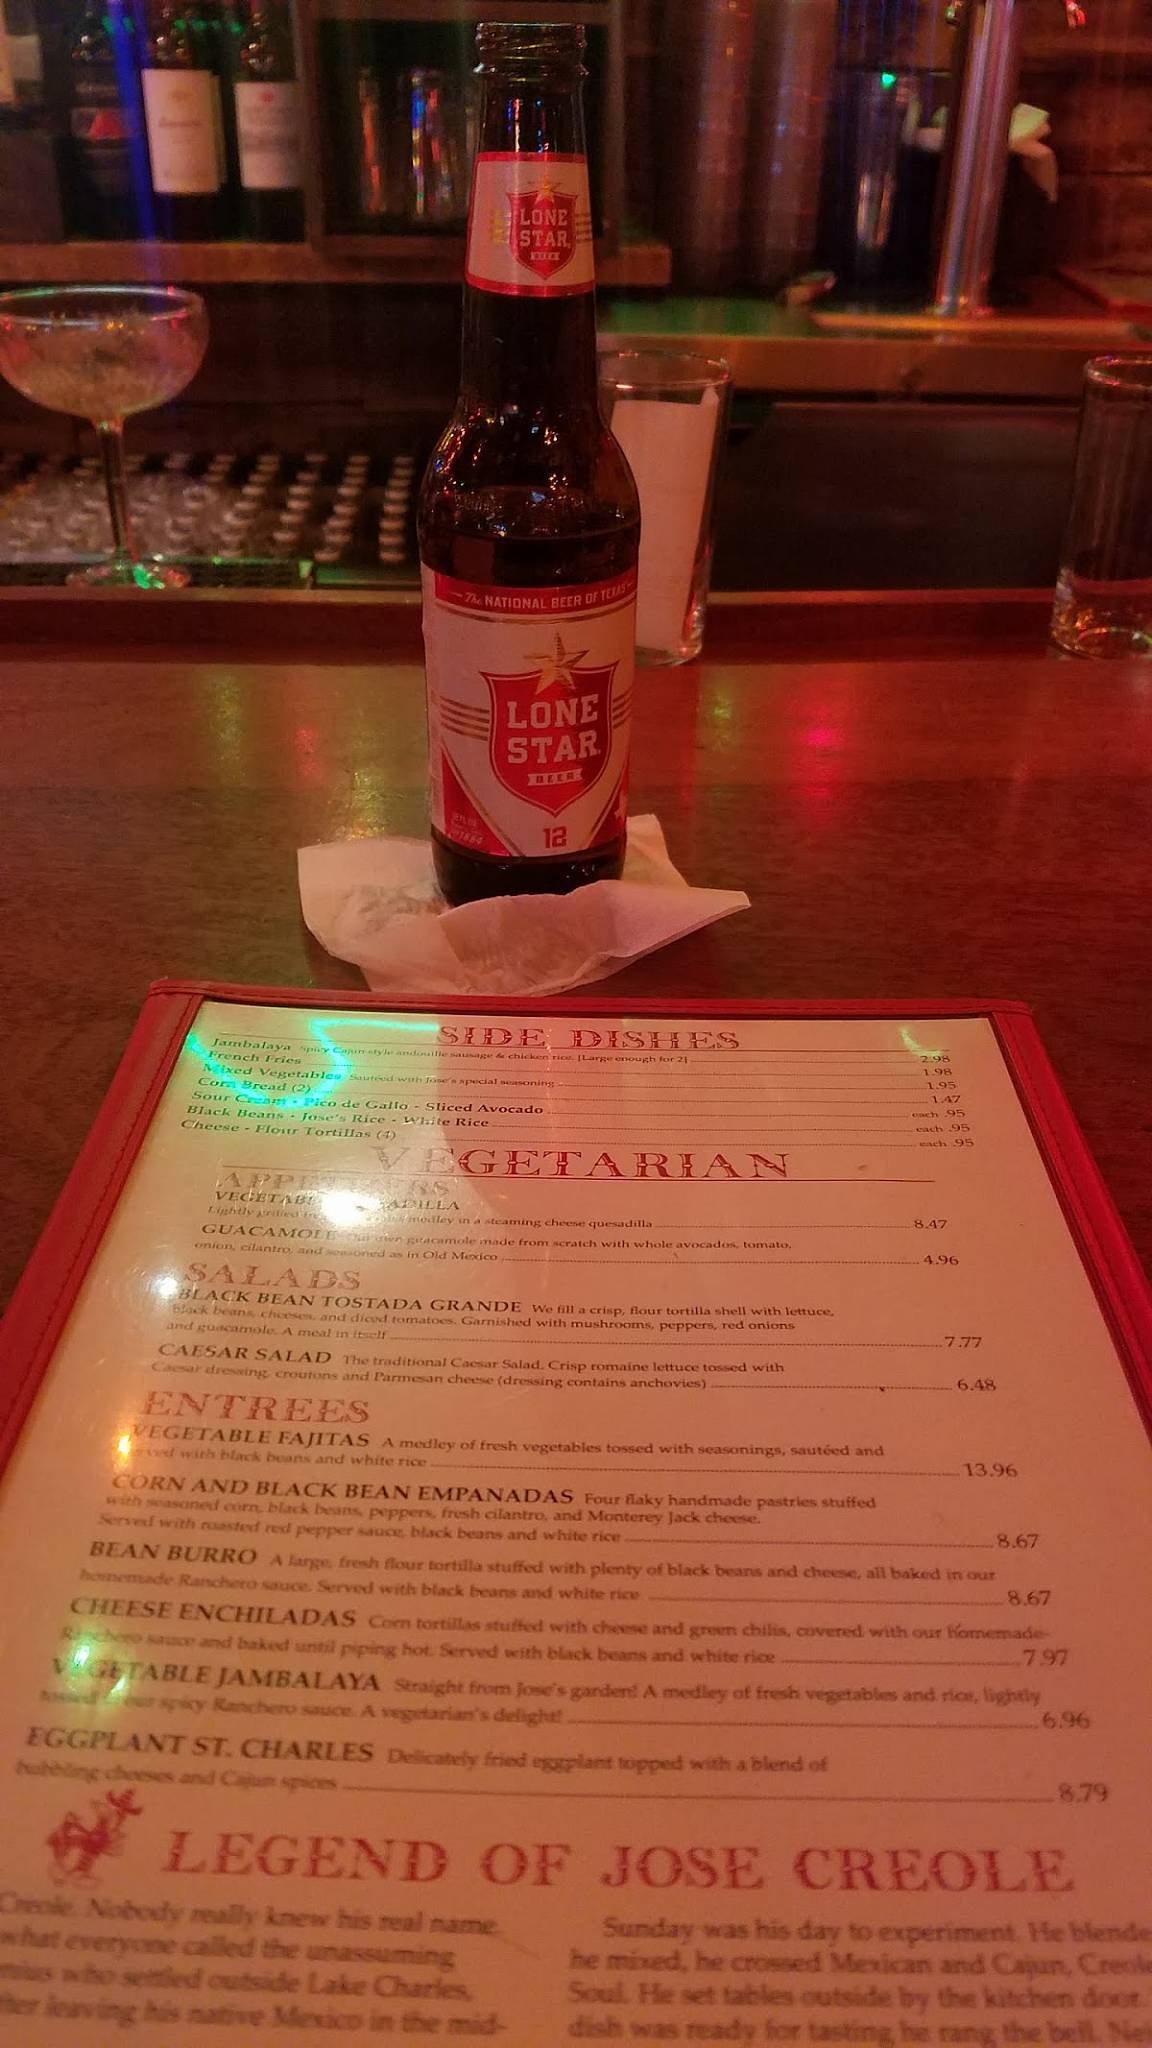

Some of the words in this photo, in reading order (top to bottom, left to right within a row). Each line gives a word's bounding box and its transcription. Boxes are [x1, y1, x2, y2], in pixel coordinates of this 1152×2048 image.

[520, 208, 568, 225] LONE
[520, 230, 569, 247] STAR
[484, 594, 547, 609] NATIONAL
[551, 593, 581, 608] BEER
[585, 591, 598, 605] OF
[600, 585, 626, 602] TEXAS
[508, 695, 599, 729] LONE
[508, 730, 600, 764] STAR
[536, 772, 575, 784] BEER
[543, 826, 567, 849] 12
[437, 1026, 546, 1047] SIDE
[569, 1029, 740, 1049] DISHES
[212, 1038, 291, 1052] Jambalaya
[615, 1055, 656, 1063] enough
[921, 1055, 950, 1063] 2.98
[203, 1064, 252, 1076] Mixed
[260, 1068, 341, 1081] Vegetables
[459, 1078, 497, 1086] special
[208, 1051, 259, 1063] French
[264, 1053, 301, 1064] Fries
[923, 1068, 952, 1076] 1.98
[198, 1077, 237, 1089] Corn
[242, 1081, 286, 1092] Bread
[292, 1083, 310, 1093] (2)
[931, 1095, 960, 1104] 1.47
[192, 1091, 231, 1102] Sour
[304, 1097, 338, 1108] Pico
[341, 1100, 360, 1109] de
[365, 1100, 409, 1110] Gallo
[426, 1102, 472, 1112] Sliced
[478, 1104, 544, 1114] Avocado
[944, 1110, 965, 1118] .95
[187, 1106, 229, 1117] Black
[236, 1108, 284, 1120] Beans
[352, 1114, 386, 1124] Rice
[403, 1116, 450, 1126] White
[455, 1118, 489, 1127] Rice
[916, 1125, 943, 1133] each
[948, 1124, 969, 1132] .95
[182, 1120, 240, 1133] Cheese
[256, 1123, 298, 1136] Flour
[306, 1127, 372, 1138] Tortillas
[376, 1129, 395, 1141] (4)
[953, 1139, 974, 1147] .95
[371, 1147, 790, 1178] VEGETARIAN
[202, 1224, 337, 1240] GUACAMOLE
[553, 1240, 597, 1248] scratch
[601, 1240, 629, 1248] with
[633, 1240, 672, 1249] whole
[914, 1220, 947, 1229] 8.47
[423, 1251, 446, 1260] Old
[452, 1252, 497, 1261] Mexico
[923, 1256, 959, 1265] 4.96
[185, 1263, 361, 1289] SALADS
[179, 1289, 250, 1302] BLACK
[258, 1293, 313, 1306] BEAN
[321, 1296, 422, 1310] TOSTADA
[430, 1299, 521, 1312] GRANDE
[532, 1304, 553, 1314] We
[557, 1304, 574, 1314] fill
[630, 1306, 662, 1315] flour
[666, 1307, 711, 1316] tortilla
[715, 1307, 746, 1316] shell
[751, 1307, 781, 1316] with
[461, 1316, 531, 1328] Garnished
[536, 1318, 566, 1328] with
[722, 1320, 744, 1330] red
[749, 1321, 795, 1330] onions
[945, 1336, 982, 1347] 7.77
[159, 1344, 247, 1359] CAESAR
[255, 1349, 331, 1363] SALAD
[343, 1355, 368, 1366] The
[373, 1355, 447, 1367] traditional
[451, 1358, 496, 1369] Caesar
[548, 1361, 587, 1373] Crisp
[591, 1362, 649, 1372] romaine
[653, 1362, 700, 1372] lettuce
[703, 1362, 746, 1372] tossed
[752, 1363, 784, 1372] with
[958, 1380, 996, 1391] 6.48
[142, 1391, 370, 1424] ENTREES
[130, 1424, 271, 1444] VEGETABLE
[278, 1432, 370, 1448] FAJITAS
[382, 1438, 393, 1448] A
[400, 1439, 455, 1451] medley
[461, 1439, 476, 1451] of
[480, 1439, 518, 1452] fresh
[522, 1442, 602, 1456] vegetables
[606, 1443, 653, 1454] tossed
[659, 1443, 694, 1455] with
[856, 1445, 884, 1456] and
[964, 1463, 1018, 1477] 13.96
[112, 1475, 185, 1490] CORN
[191, 1480, 248, 1495] AND
[256, 1482, 336, 1498] BLACK
[346, 1484, 410, 1500] BEAN
[419, 1486, 574, 1504] EMPANADAS
[90, 1541, 159, 1558] BEAN
[167, 1545, 256, 1565] BURRO
[997, 1534, 1039, 1548] 8.67
[1008, 1591, 1050, 1606] 8.67
[71, 1598, 174, 1618] CHEESE
[180, 1603, 356, 1627] ENCHILADAS
[1023, 1649, 1068, 1667] 7.97
[218, 1666, 381, 1691] JAMBALAYA
[1042, 1712, 1090, 1729] 6.96
[27, 1726, 184, 1754] EGGPLANT
[192, 1737, 232, 1757] ST.
[241, 1738, 373, 1761] CHARLES
[1058, 1783, 1109, 1802] 8.79
[162, 1831, 448, 1883] LEGEND
[480, 1842, 570, 1886] OF
[600, 1845, 765, 1891] JOSE
[792, 1847, 1074, 1892] CREOLE
[602, 1917, 694, 1943] Sunday
[703, 1922, 748, 1939] was
[754, 1919, 790, 1940] his
[796, 1920, 840, 1944] day
[848, 1922, 872, 1940] to
